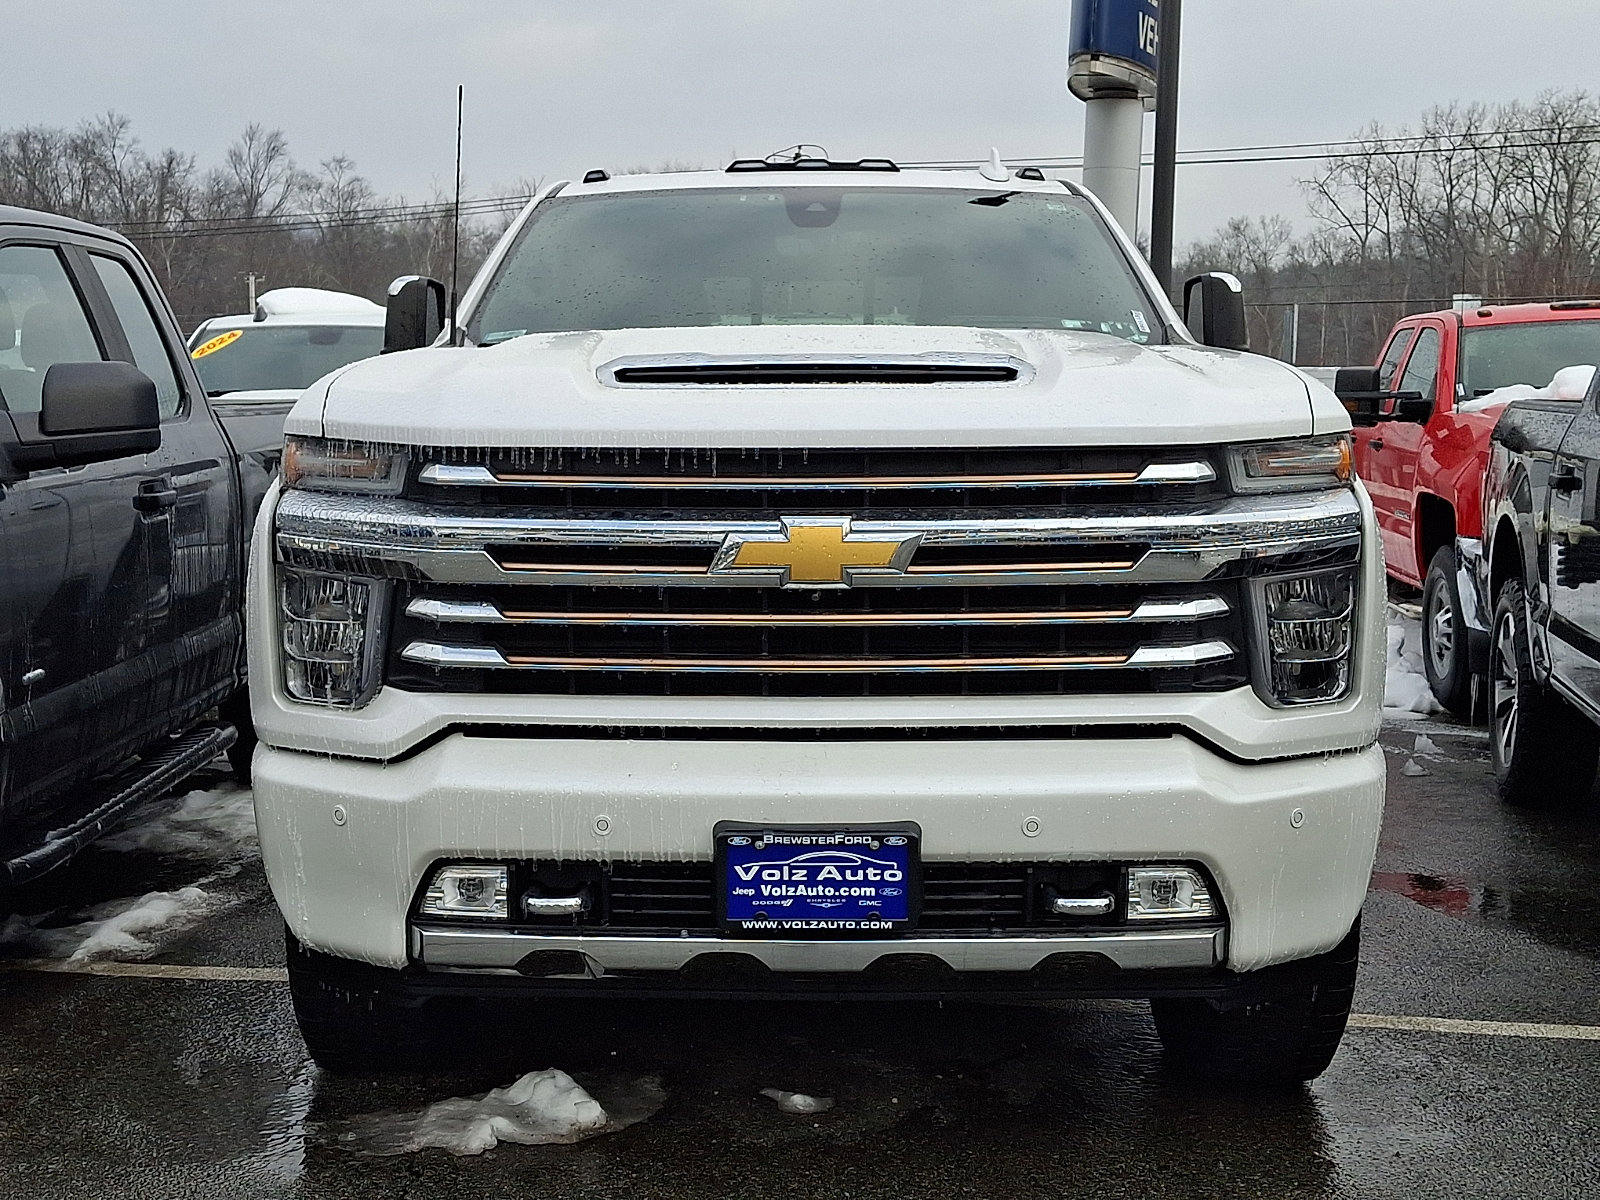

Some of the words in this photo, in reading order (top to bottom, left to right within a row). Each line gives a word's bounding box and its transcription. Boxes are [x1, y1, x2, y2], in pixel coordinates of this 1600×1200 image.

[196, 332, 237, 355] 2024
[733, 865, 808, 881] Volz
[815, 865, 903, 882] Auto
[732, 886, 756, 897] Jeep
[760, 884, 876, 897] VolzAuto.com
[880, 887, 902, 897] Ford
[741, 920, 893, 930] WWW.VOLZAUTO.COM
